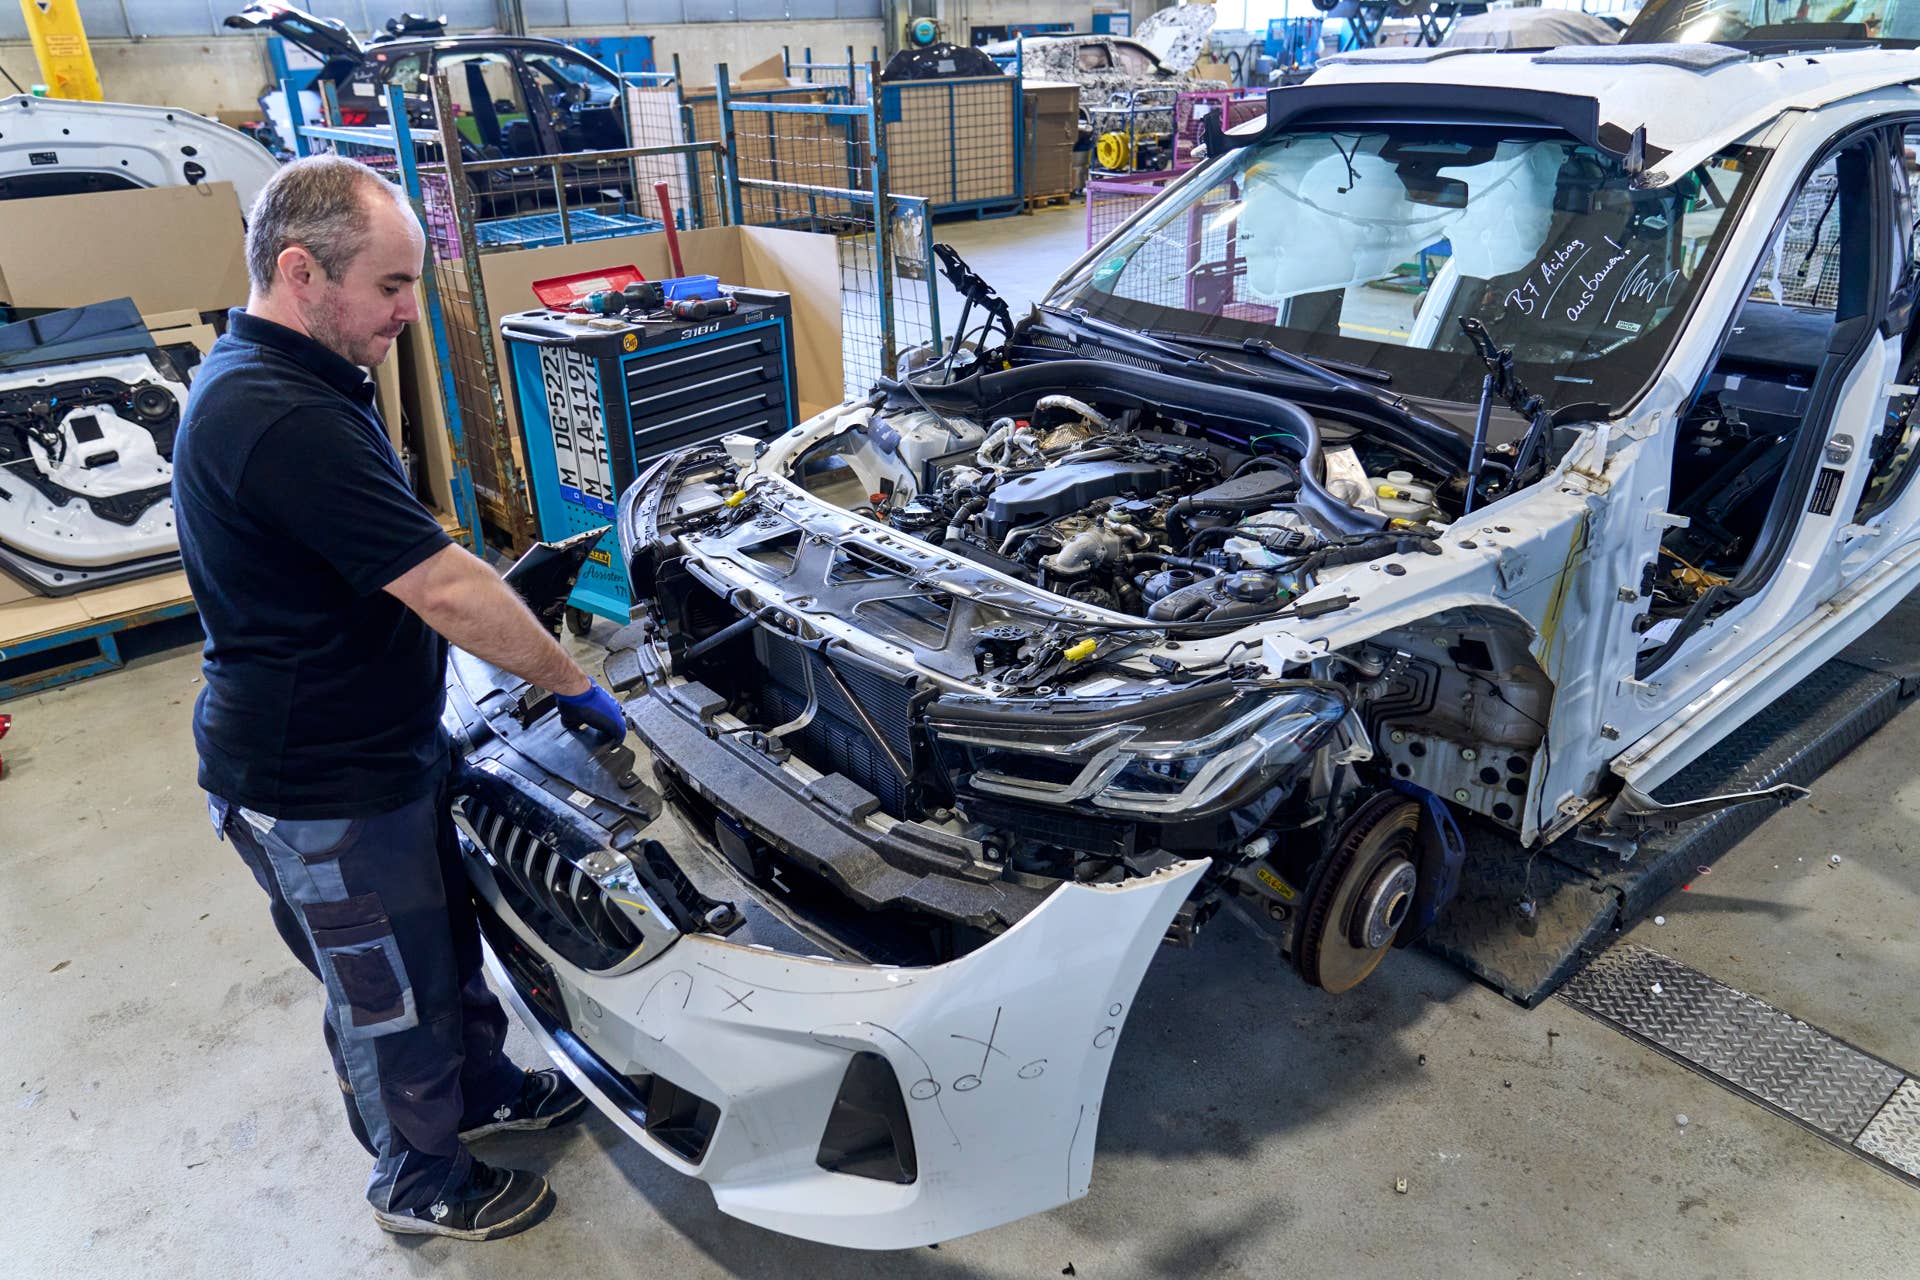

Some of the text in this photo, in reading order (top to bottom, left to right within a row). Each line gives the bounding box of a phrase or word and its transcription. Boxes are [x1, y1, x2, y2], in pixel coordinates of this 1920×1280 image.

[1541, 239, 1585, 285] Airbag
[1566, 235, 1631, 321] ausbauen!
[680, 322, 720, 340] 318d
[560, 467, 578, 487] M
[584, 477, 602, 498] M
